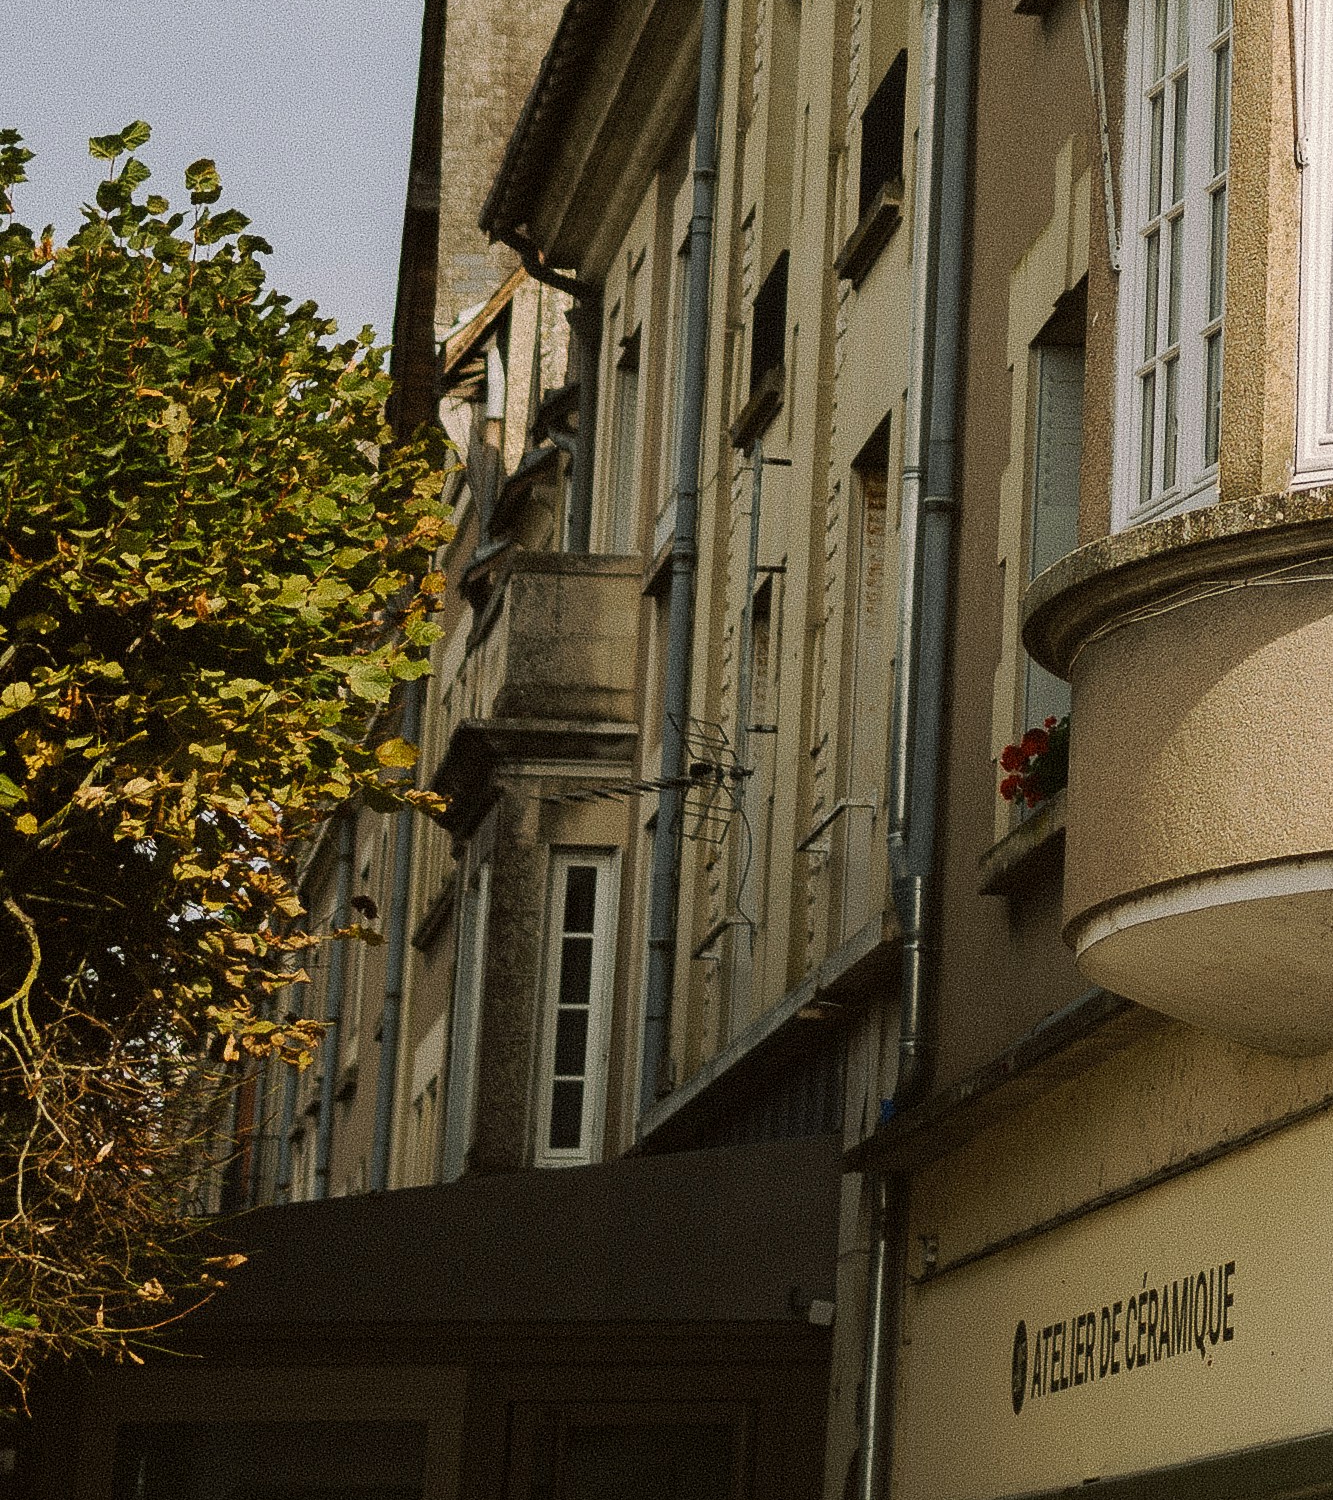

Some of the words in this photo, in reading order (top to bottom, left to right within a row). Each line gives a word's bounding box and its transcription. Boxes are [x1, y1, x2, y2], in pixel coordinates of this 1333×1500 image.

[1030, 1312, 1096, 1399] ATELIER
[1100, 1301, 1123, 1379] DE
[1125, 1261, 1236, 1371] CÉRAMIQUE
